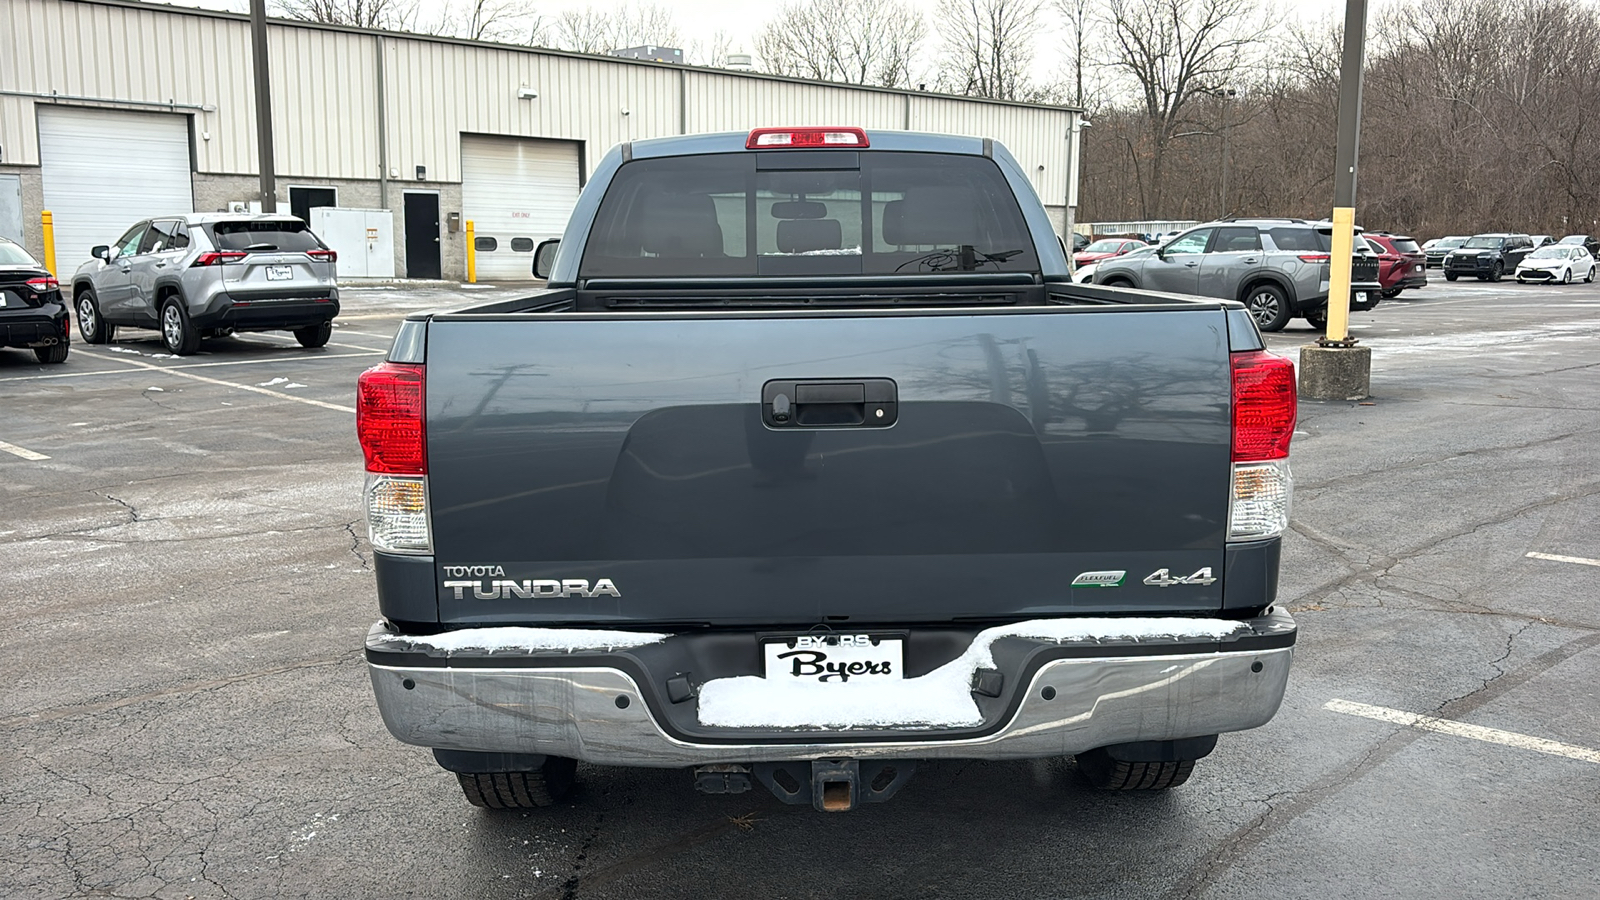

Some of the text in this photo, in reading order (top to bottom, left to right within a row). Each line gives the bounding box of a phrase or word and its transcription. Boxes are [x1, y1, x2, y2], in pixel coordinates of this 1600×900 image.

[443, 565, 505, 577] TOYOTA
[443, 578, 622, 600] TUNDRA
[797, 635, 870, 648] BYRS
[777, 650, 892, 682] Byers
